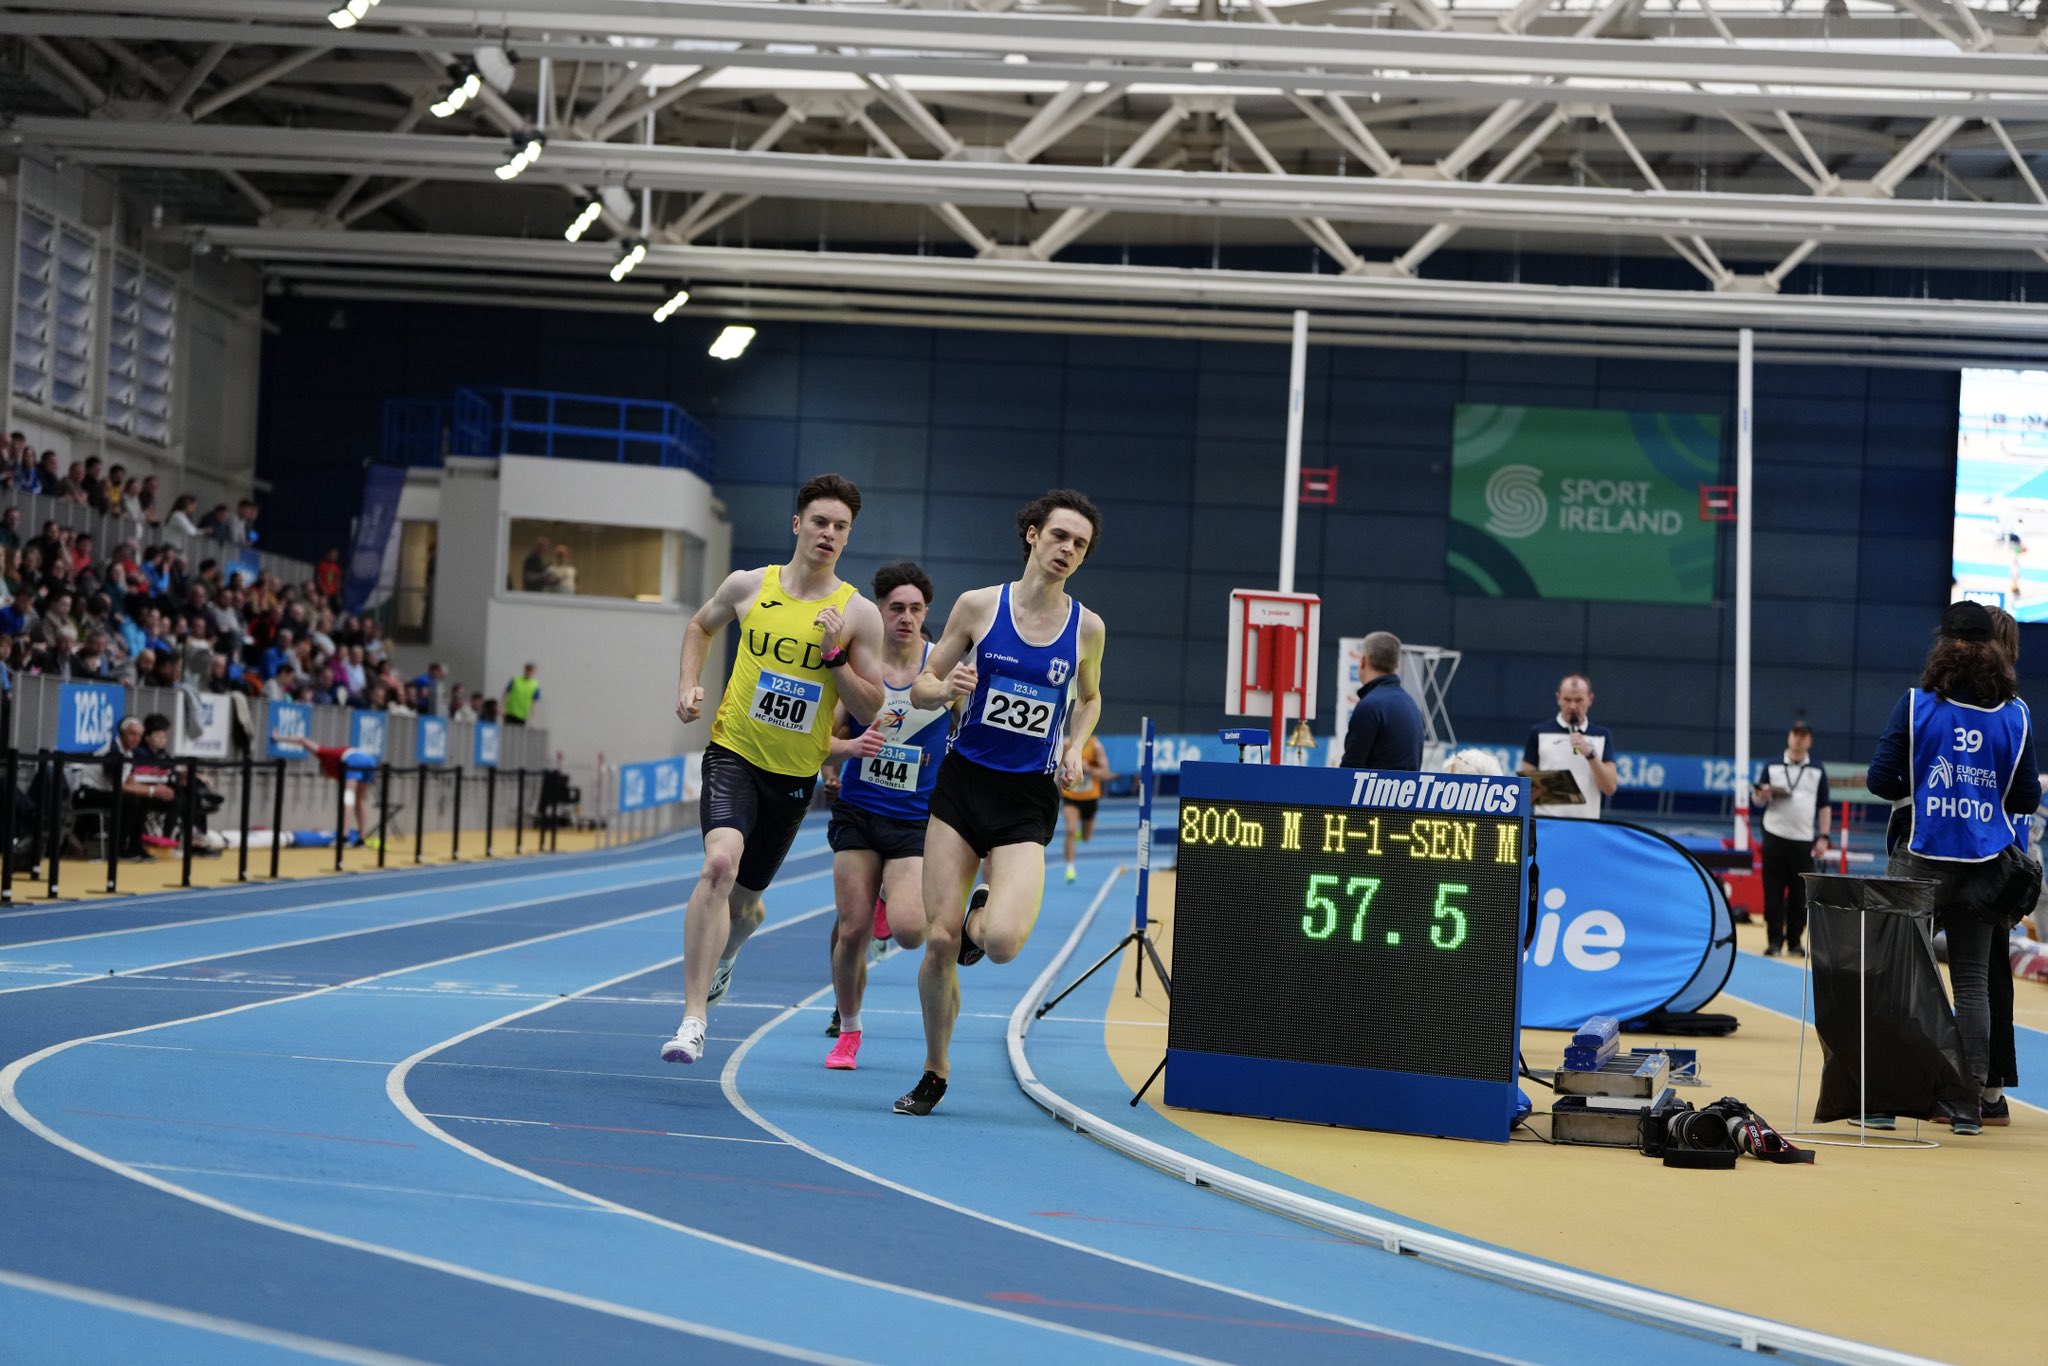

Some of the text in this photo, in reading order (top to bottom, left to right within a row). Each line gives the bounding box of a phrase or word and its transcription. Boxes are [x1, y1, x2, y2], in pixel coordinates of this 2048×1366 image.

[1559, 478, 1650, 506] SPORT
[1559, 506, 1682, 536] IRELAND
[749, 628, 825, 671] UCD
[771, 677, 805, 696] 123.ie
[1013, 683, 1038, 697] 123.ie
[759, 691, 807, 724] 450
[986, 694, 1050, 734] 232
[755, 712, 804, 731] MC PHILLIPS
[1952, 727, 1983, 753] 39
[879, 747, 906, 760] 23.ie
[869, 758, 908, 783] 444
[874, 778, 906, 789] DONNELL
[1617, 756, 1665, 788] 3.ie
[1956, 764, 1997, 778] EUROPEA
[1351, 771, 1520, 813] TimeTronics
[1926, 796, 1994, 823] PHOTO
[1182, 805, 1265, 847] 800m
[1323, 813, 1477, 861] H-1-SEN
[1749, 1125, 1760, 1139] EOS
